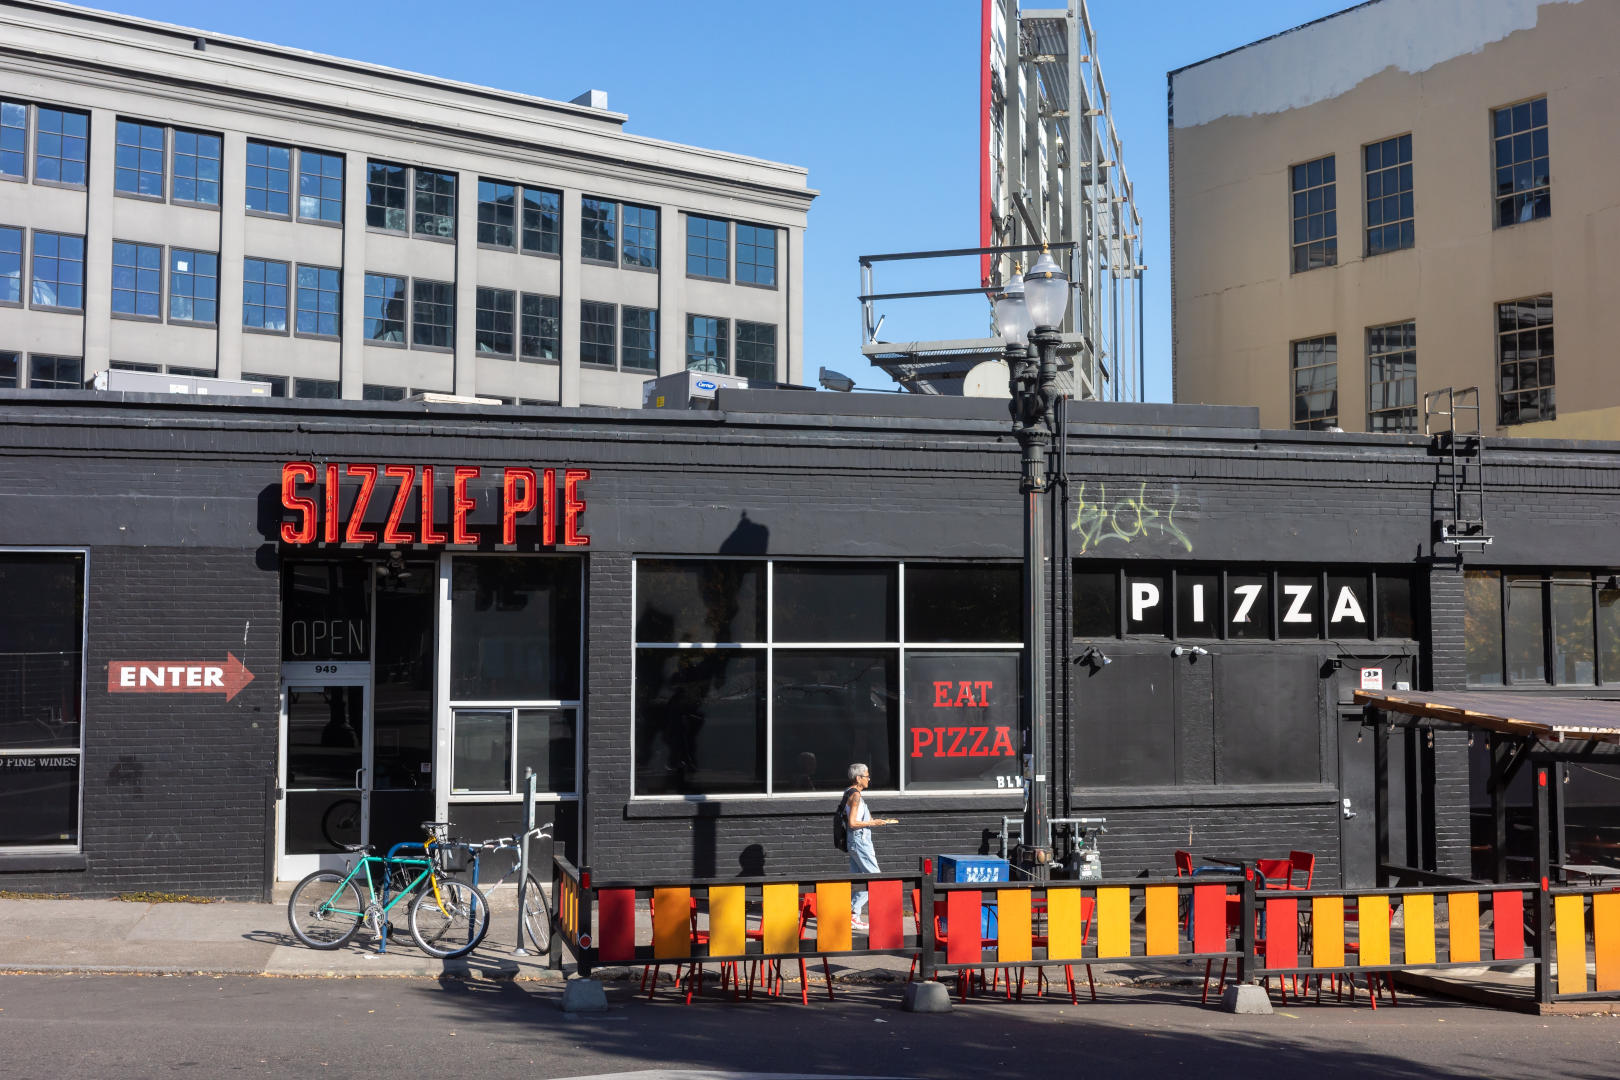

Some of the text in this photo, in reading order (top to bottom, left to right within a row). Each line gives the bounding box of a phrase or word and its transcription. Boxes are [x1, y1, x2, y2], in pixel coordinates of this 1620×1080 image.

[281, 461, 591, 547] SIZZLE PIE
[291, 620, 363, 655] OPEN
[119, 666, 225, 687] ENTER
[315, 665, 338, 674] 949
[932, 680, 993, 708] EAT
[910, 725, 1016, 758] PIZZA
[7, 758, 36, 767] FINE
[40, 757, 77, 767] WINES
